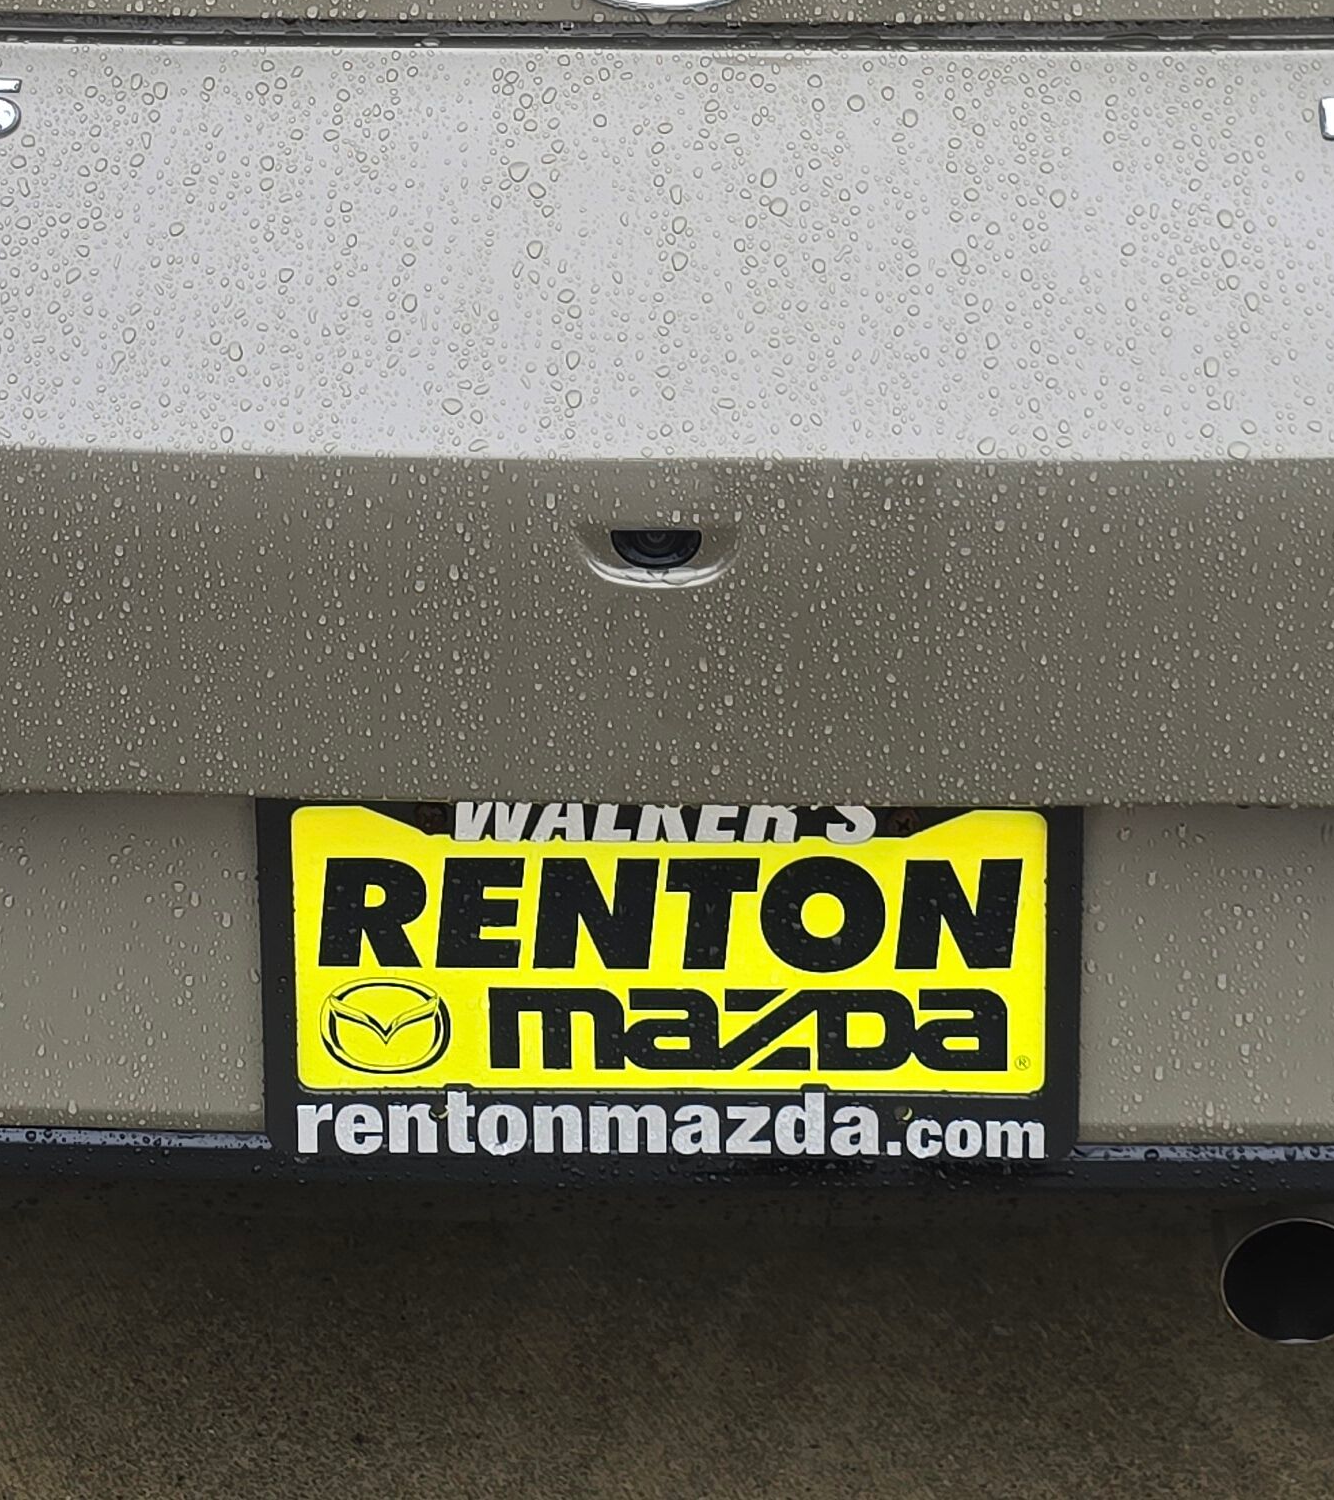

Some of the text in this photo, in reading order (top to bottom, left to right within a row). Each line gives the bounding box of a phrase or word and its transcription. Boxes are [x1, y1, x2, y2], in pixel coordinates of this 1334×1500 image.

[453, 801, 876, 844] WALKERS
[317, 856, 1023, 973] RENTON
[488, 987, 1009, 1072] mazda
[296, 1091, 1045, 1159] rentonmazda.com
